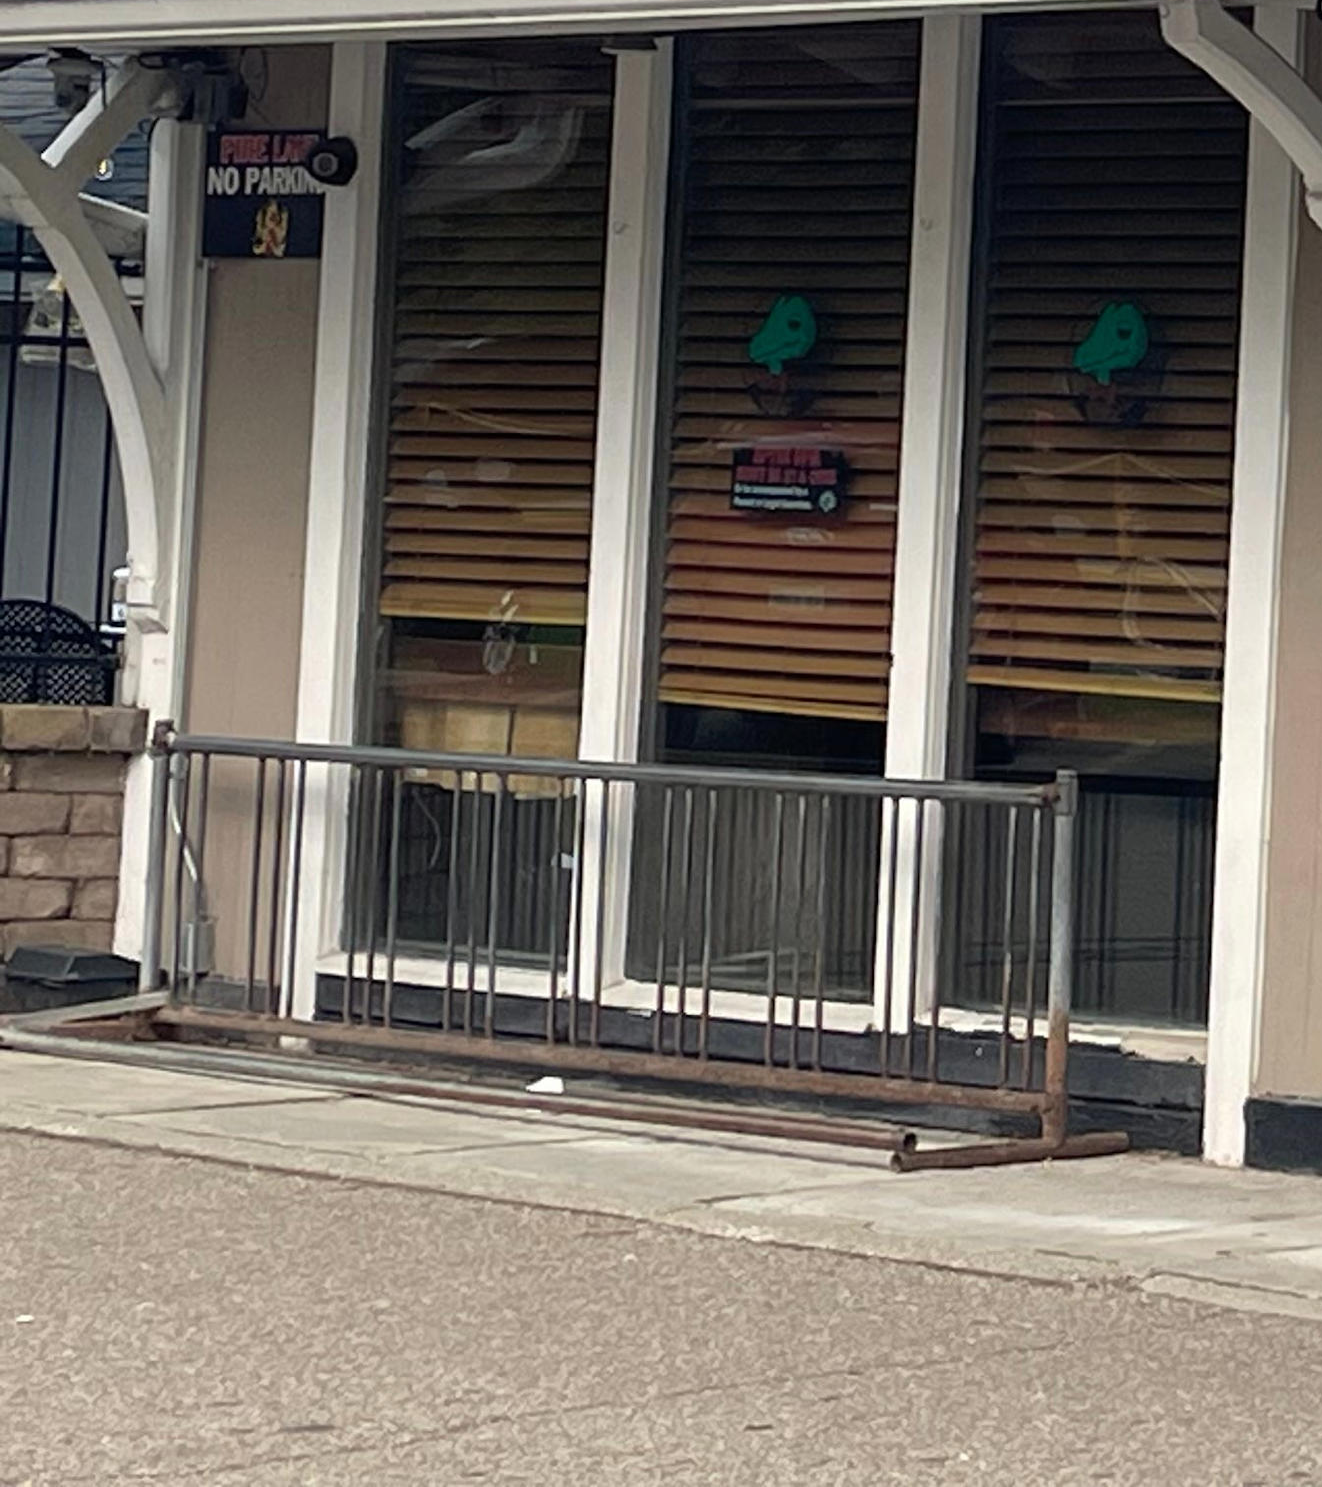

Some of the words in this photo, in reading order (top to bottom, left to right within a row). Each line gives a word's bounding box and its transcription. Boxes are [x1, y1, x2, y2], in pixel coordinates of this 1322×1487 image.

[220, 134, 269, 164] FIRE
[207, 166, 240, 195] NO
[244, 166, 323, 195] PARKIN
